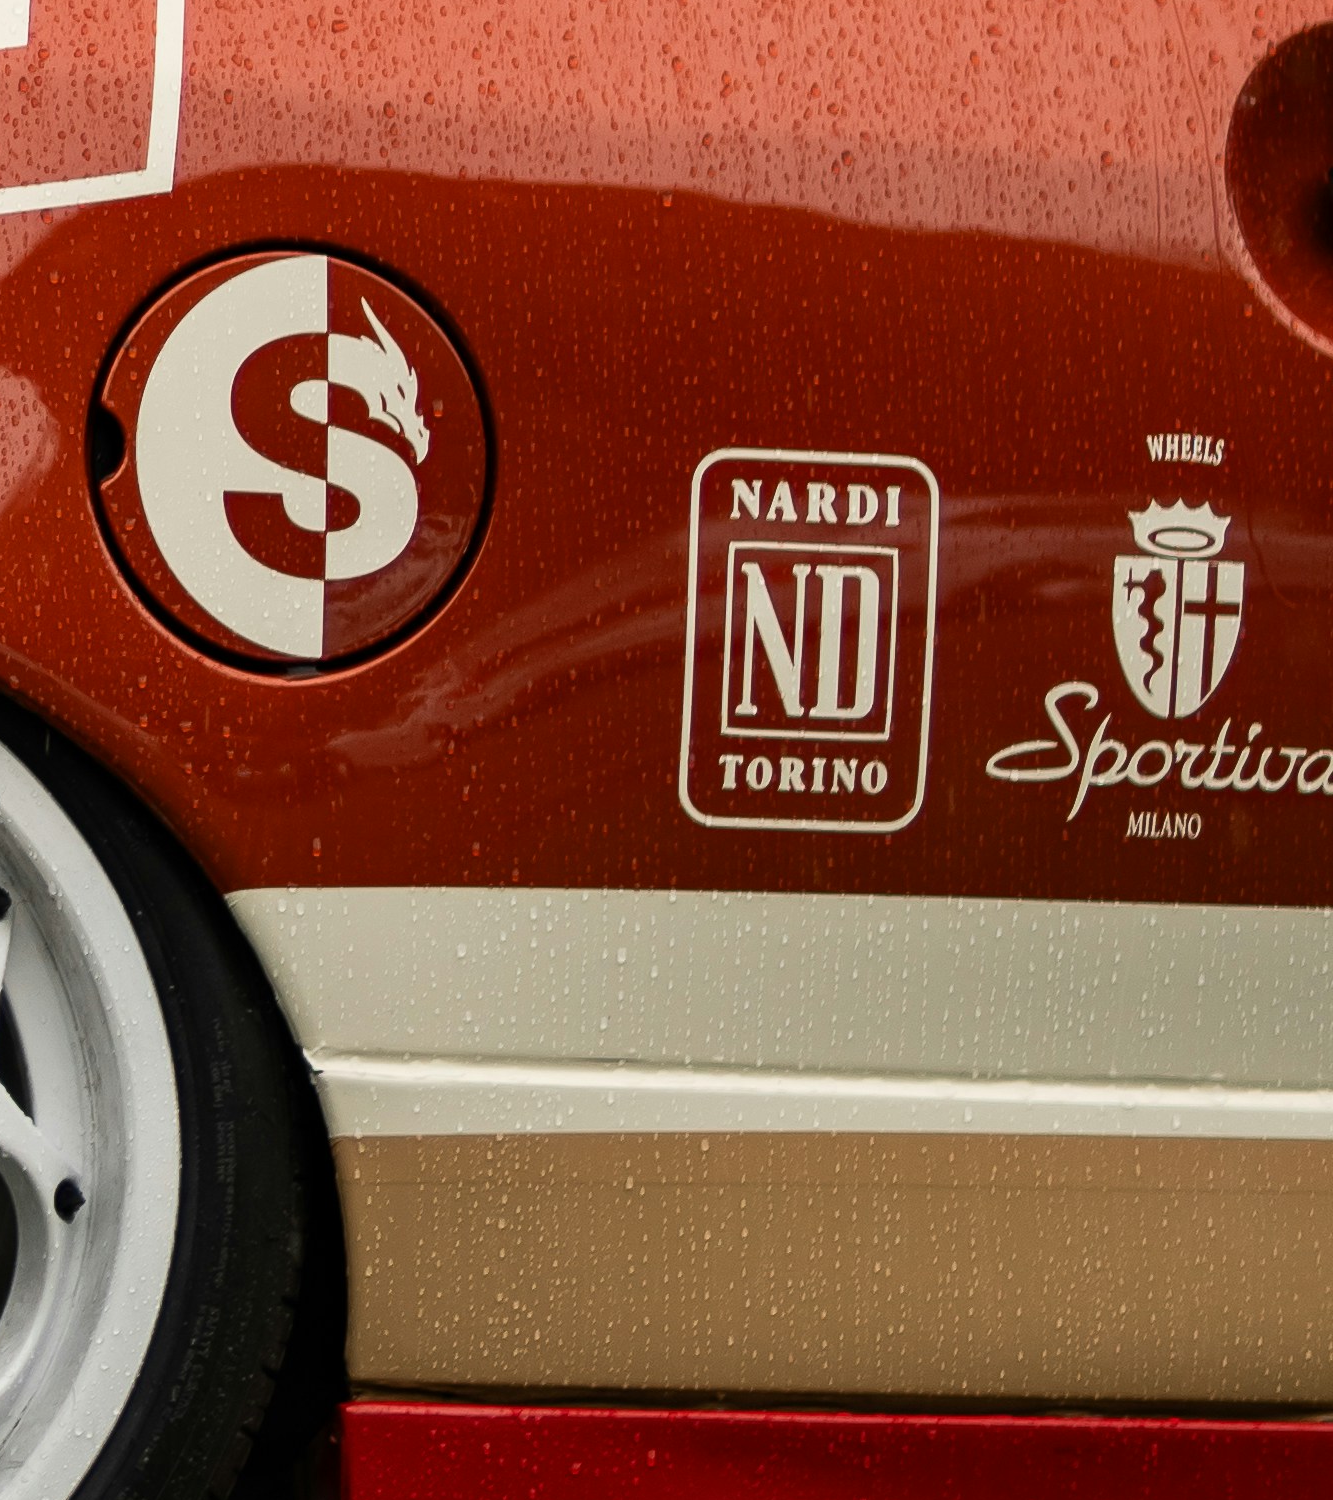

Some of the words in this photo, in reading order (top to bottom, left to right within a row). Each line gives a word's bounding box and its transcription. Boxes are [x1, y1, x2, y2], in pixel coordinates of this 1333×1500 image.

[1145, 432, 1226, 468] WHEELS
[729, 478, 902, 528] NARDI
[734, 560, 882, 721] ND
[719, 753, 889, 796] TORINO
[985, 680, 1333, 824] Sportiva
[1124, 810, 1203, 840] MILANO
